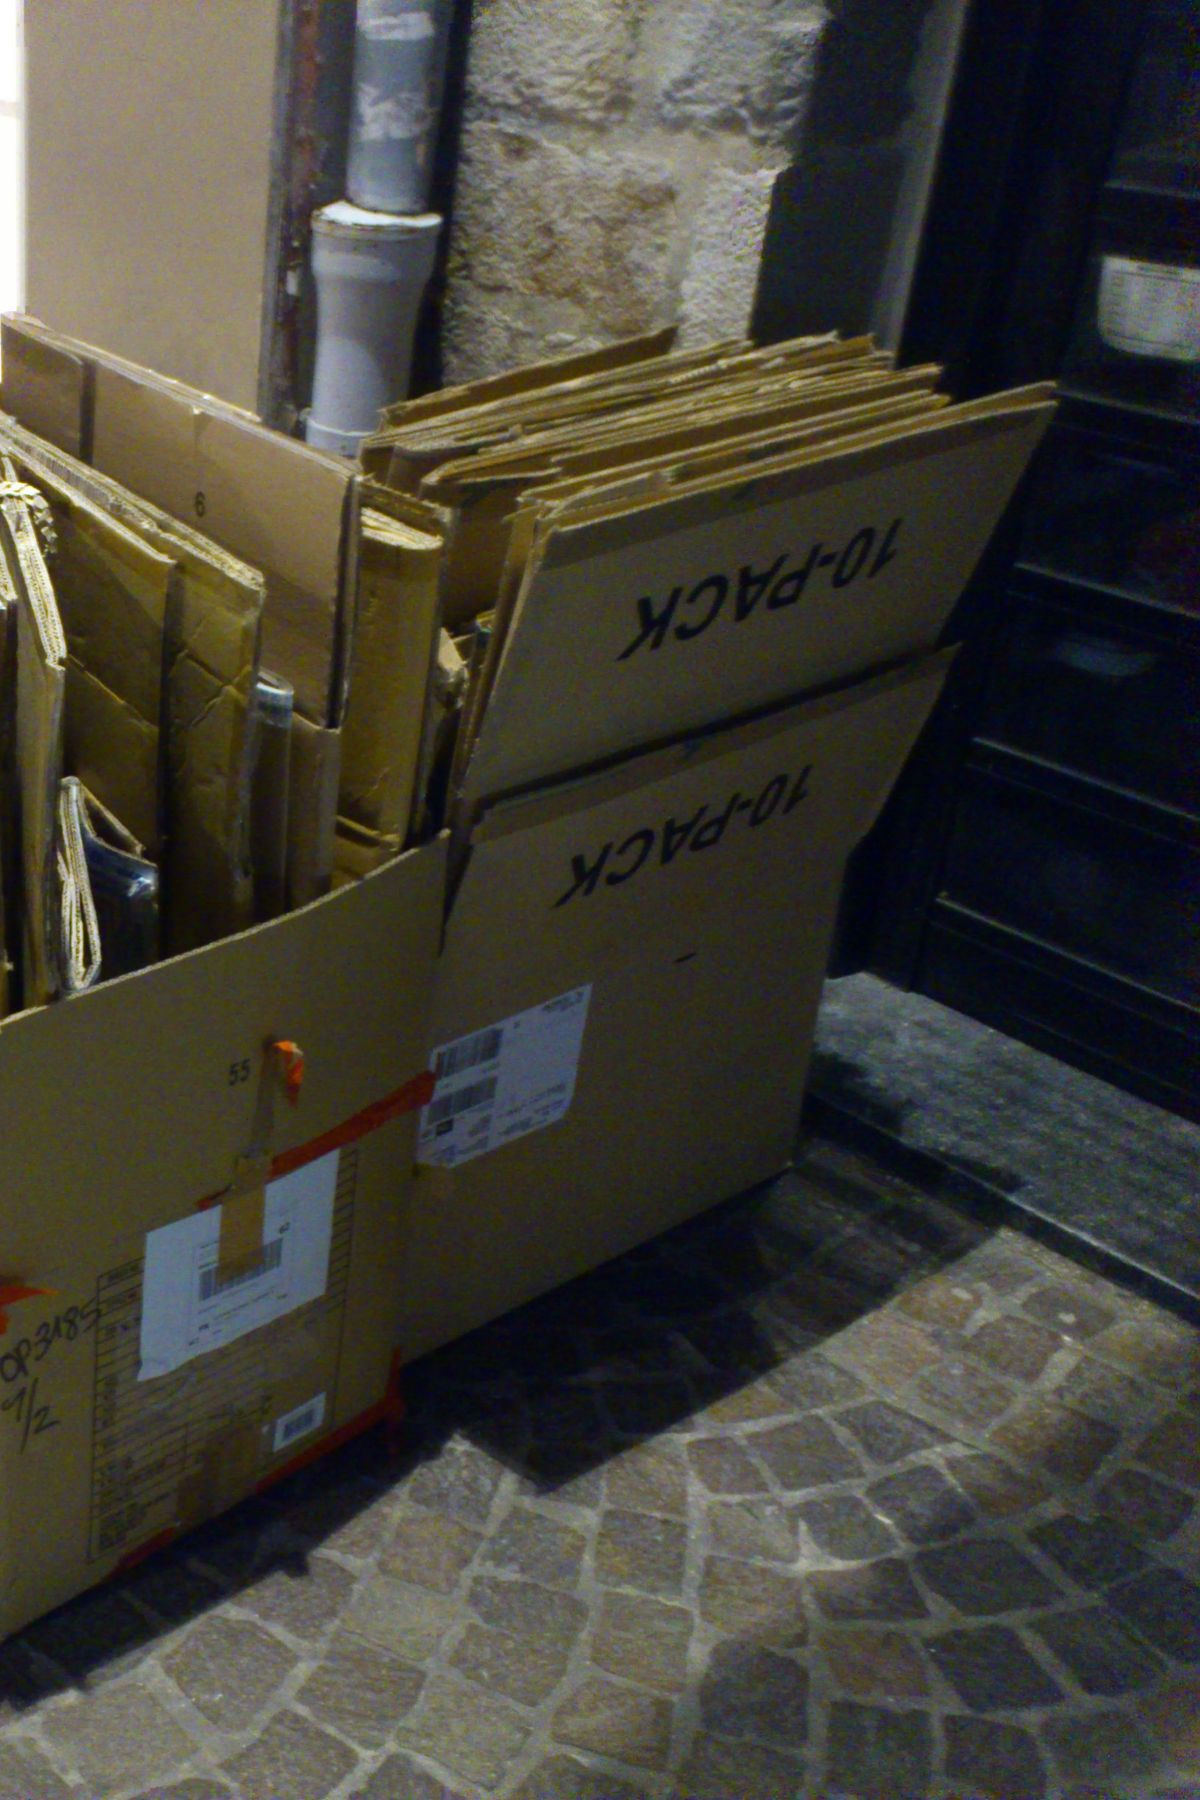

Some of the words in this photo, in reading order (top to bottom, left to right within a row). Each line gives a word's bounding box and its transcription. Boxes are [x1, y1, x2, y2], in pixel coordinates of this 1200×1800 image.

[616, 518, 903, 661] 10-PACK
[554, 764, 813, 908] 10-PACK
[229, 1058, 250, 1086] 55
